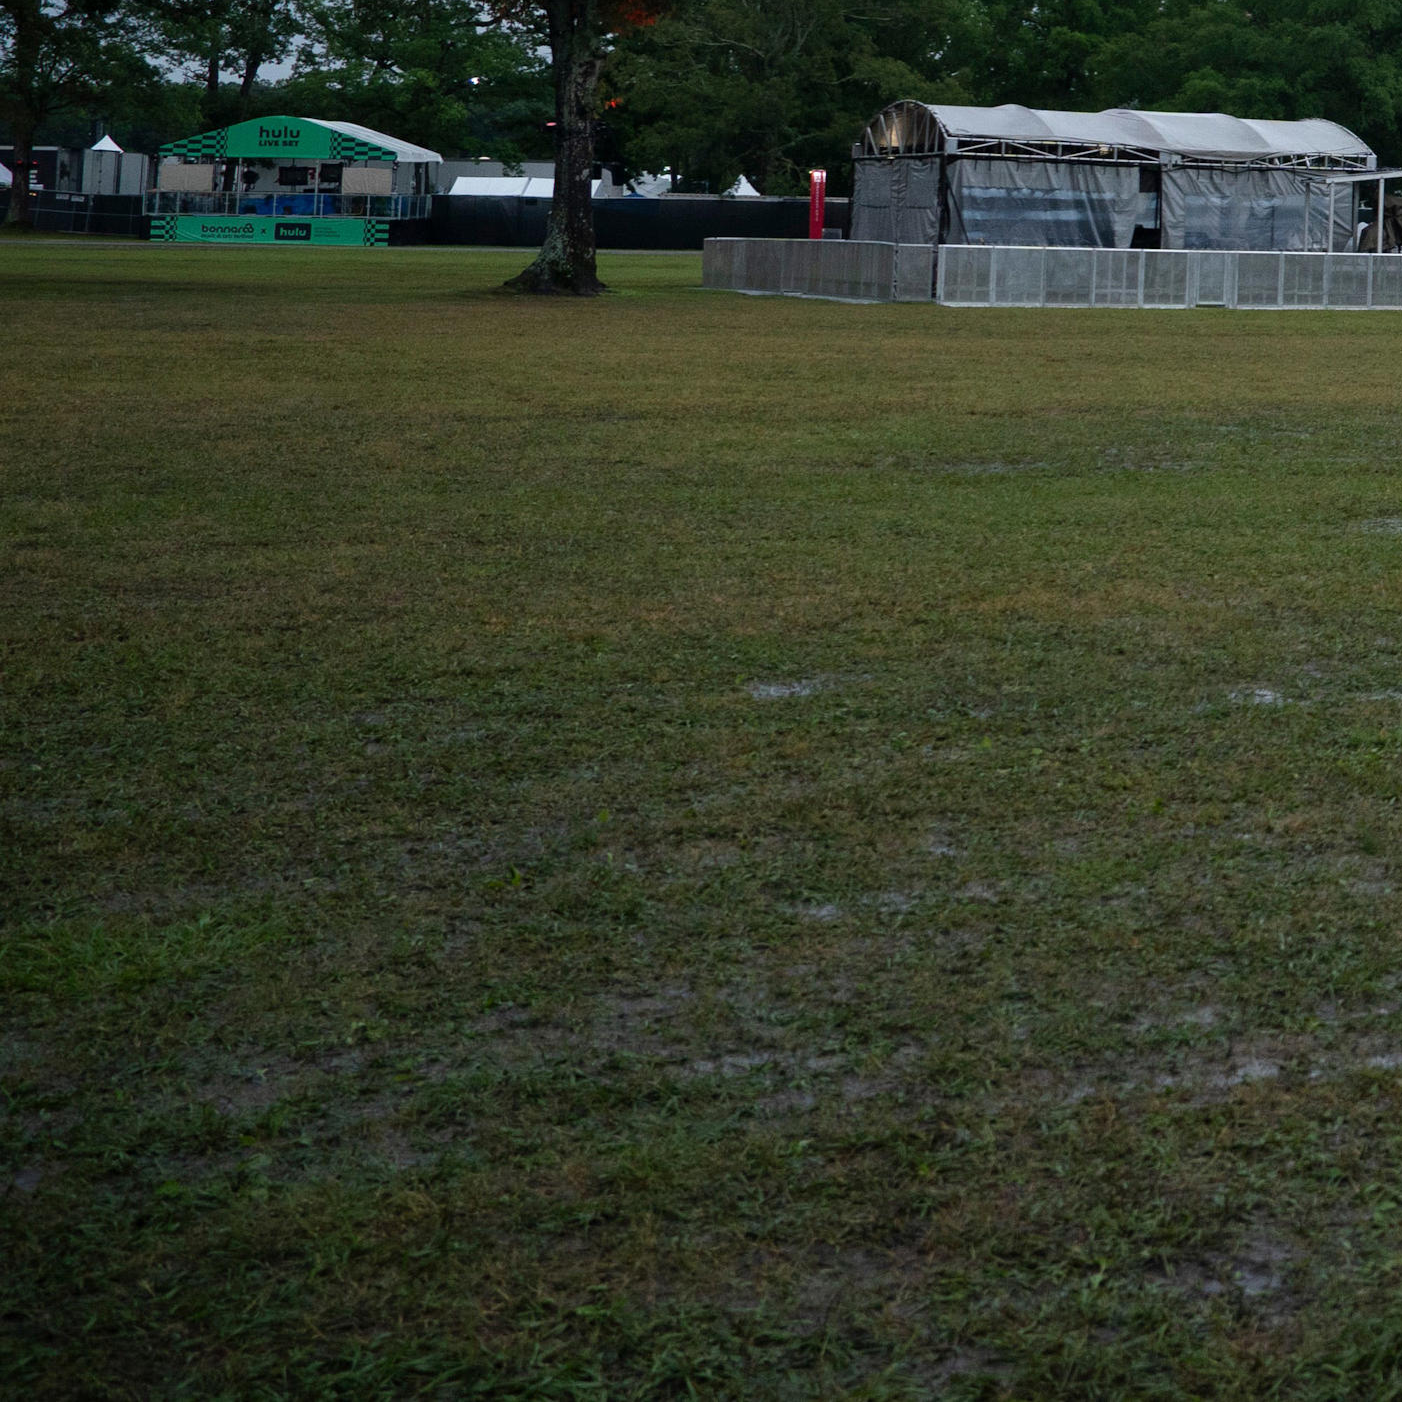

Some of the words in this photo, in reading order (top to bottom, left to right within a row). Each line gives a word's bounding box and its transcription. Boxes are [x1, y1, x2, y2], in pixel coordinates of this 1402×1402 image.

[259, 126, 300, 138] hulu
[258, 139, 280, 147] LIVE
[282, 139, 299, 147] SET
[279, 227, 307, 237] hulu
